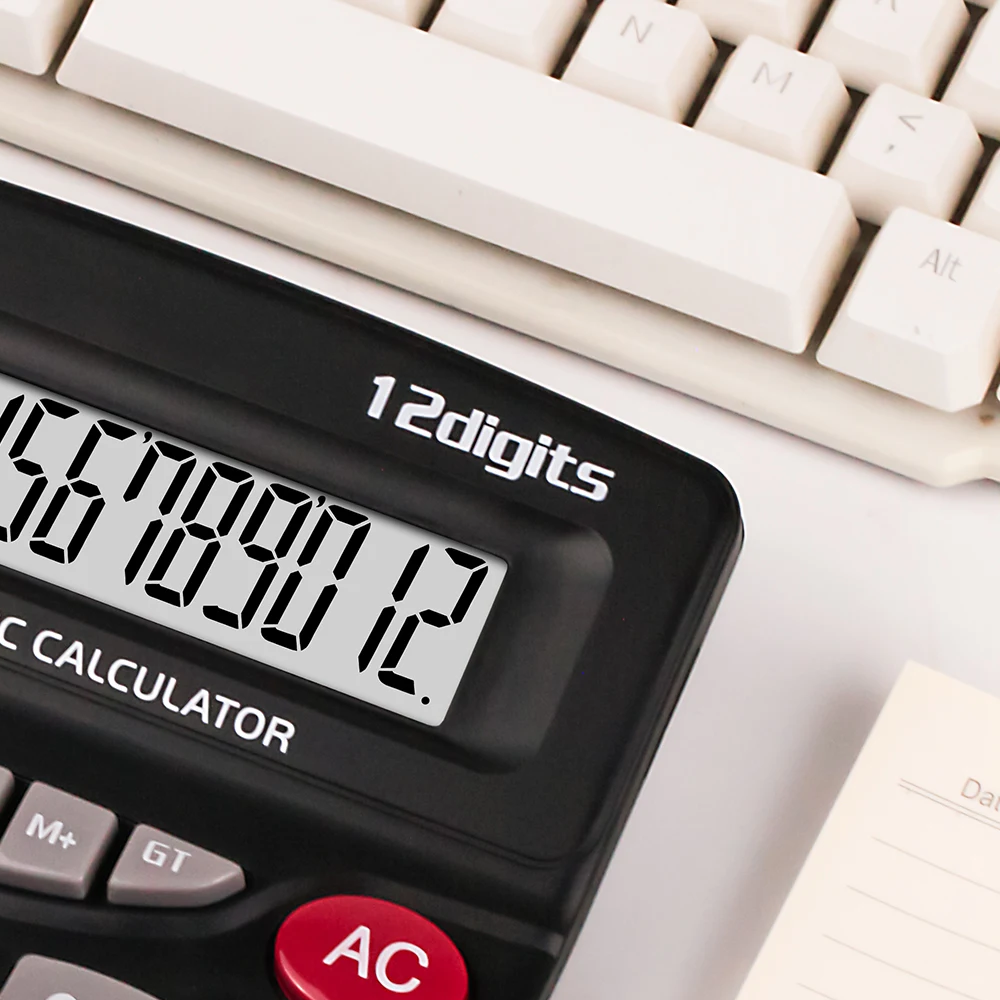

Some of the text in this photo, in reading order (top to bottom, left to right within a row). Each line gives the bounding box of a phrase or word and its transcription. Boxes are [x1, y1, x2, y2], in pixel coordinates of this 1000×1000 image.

[619, 14, 654, 45] N
[751, 60, 794, 95] M
[919, 246, 963, 284] Alt
[31, 629, 297, 755] CALCULATOR
[25, 811, 77, 852] M+
[141, 838, 194, 873] GT
[322, 925, 430, 993] AC
